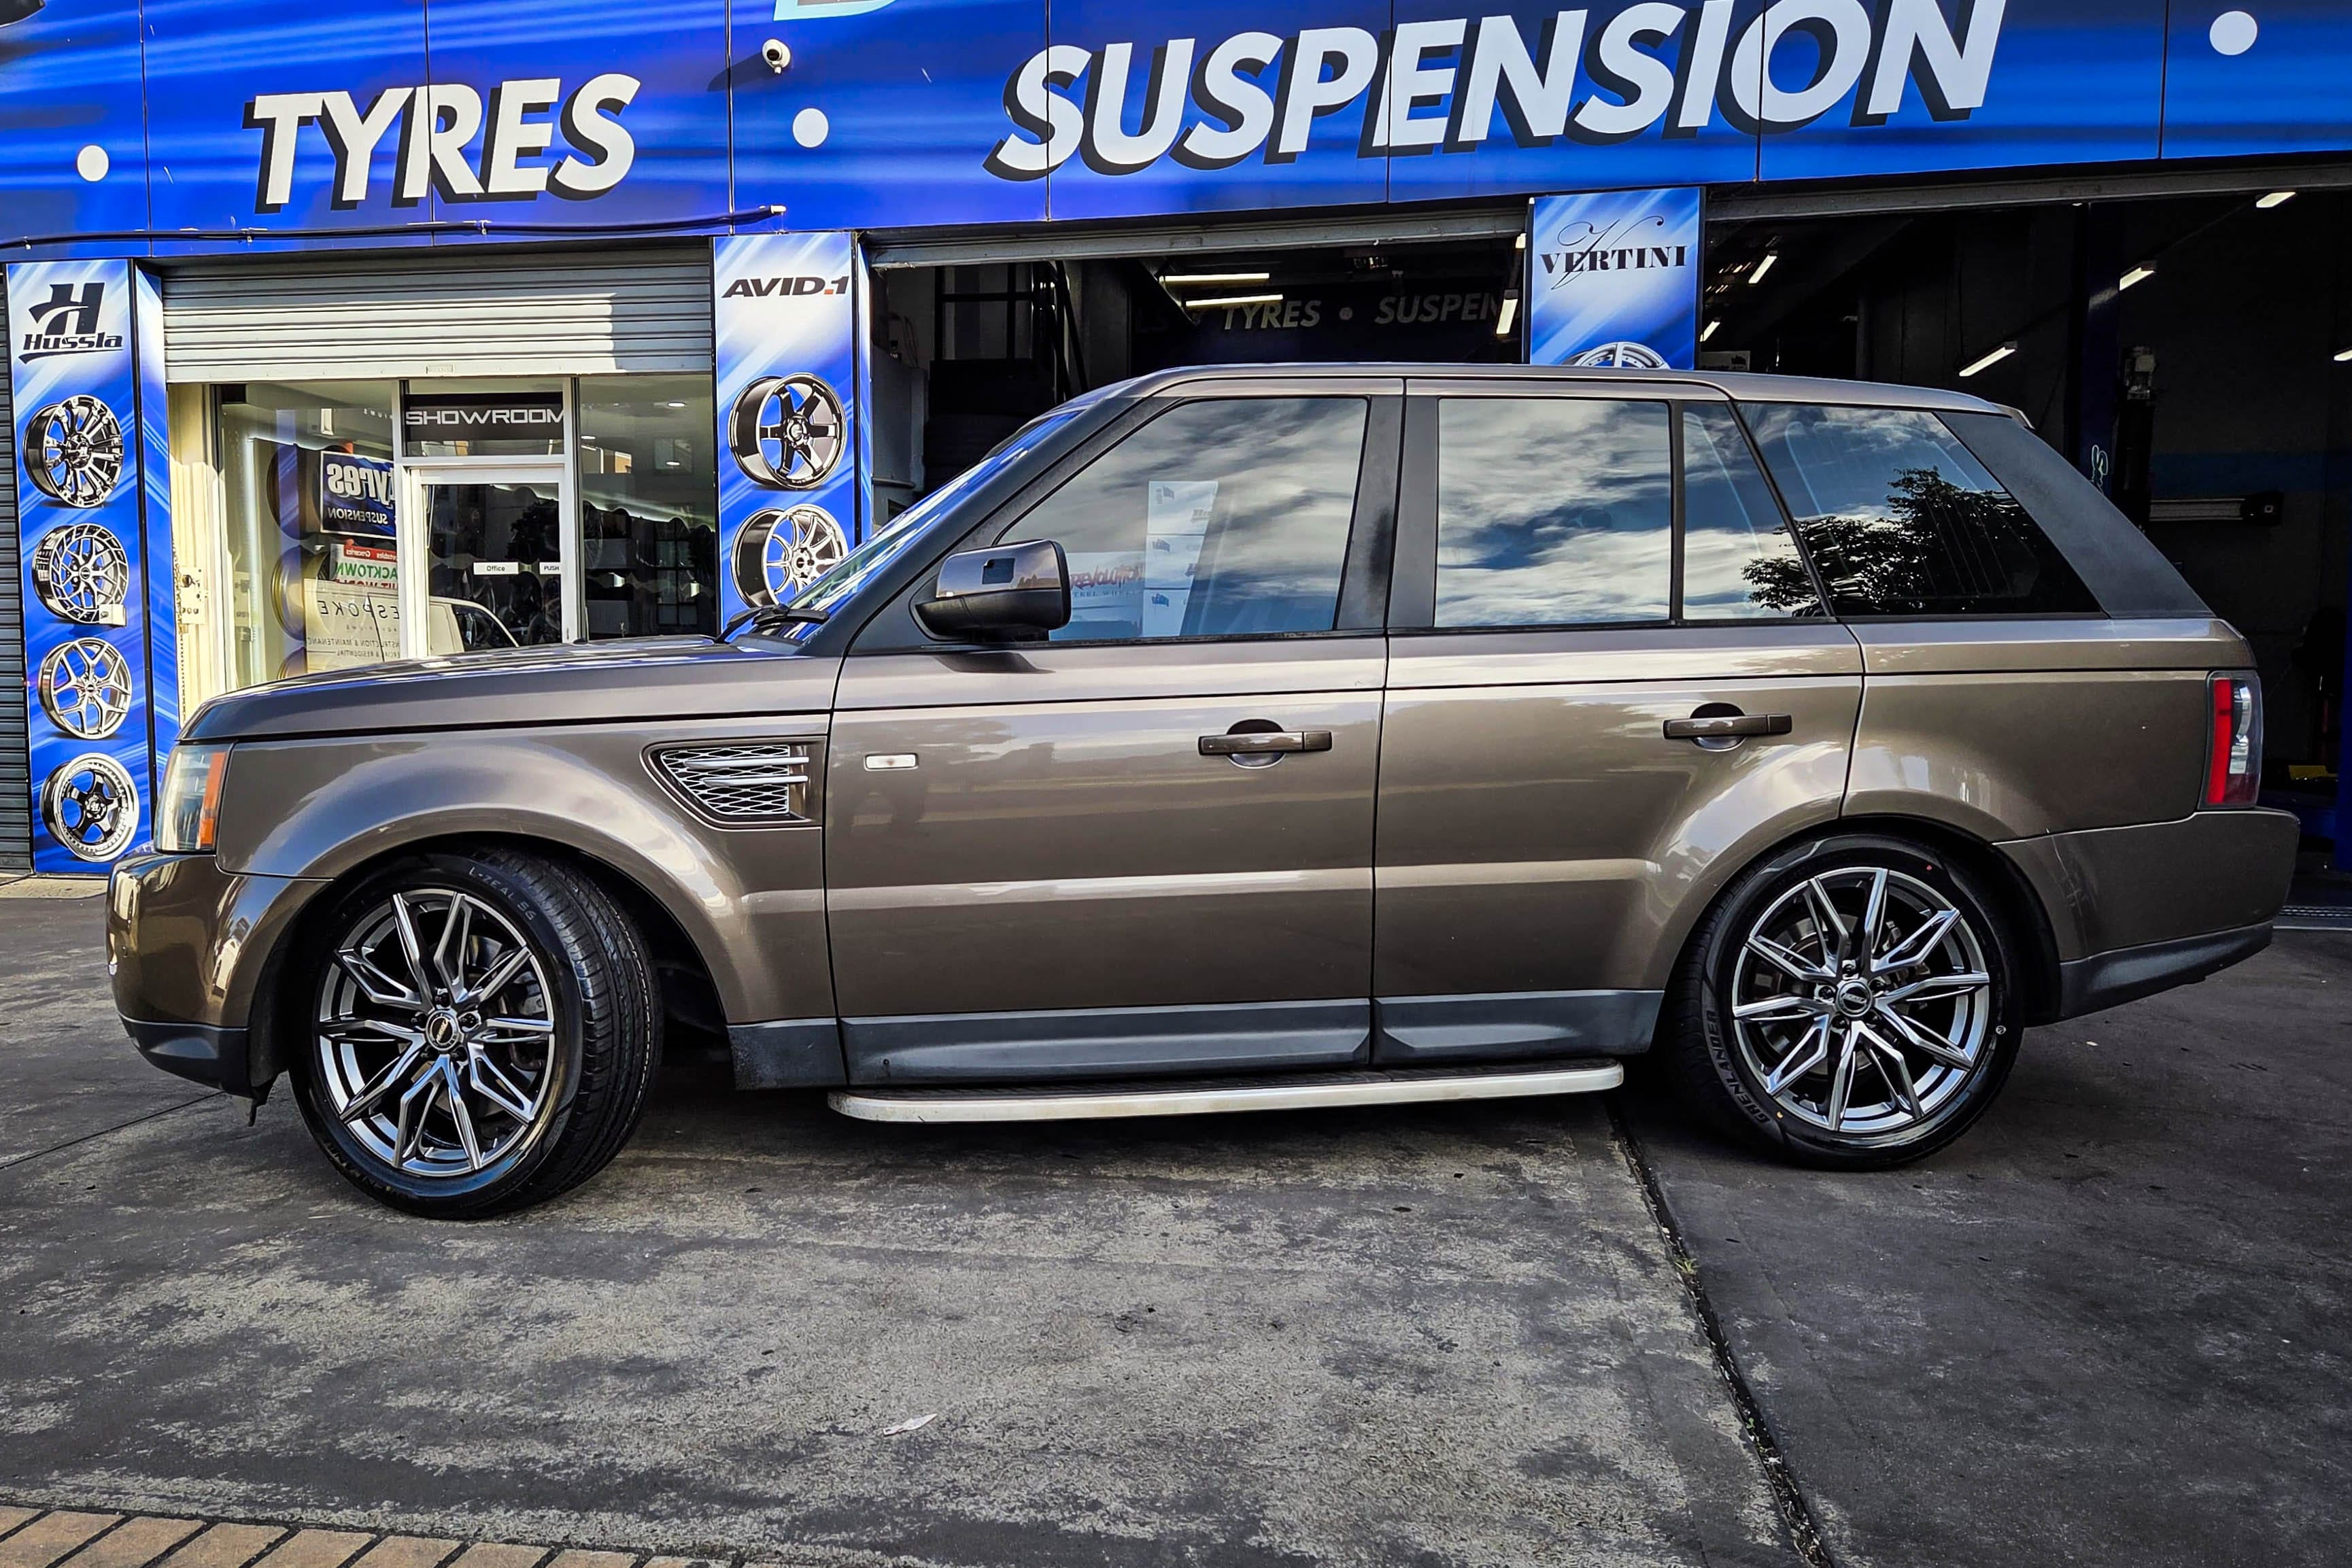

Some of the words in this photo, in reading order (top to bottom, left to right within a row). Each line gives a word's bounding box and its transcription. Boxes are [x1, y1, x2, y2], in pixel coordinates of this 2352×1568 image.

[986, 0, 2007, 180] SUSPENSION
[245, 73, 641, 212] TYRES
[1539, 245, 1688, 274] VERTINI
[721, 276, 849, 298] AVID.1
[1223, 299, 1322, 330] TYRES
[22, 332, 123, 351] Hussla
[405, 408, 564, 425] SHOWROOM
[1706, 1010, 1771, 1124] GRENLANDER
